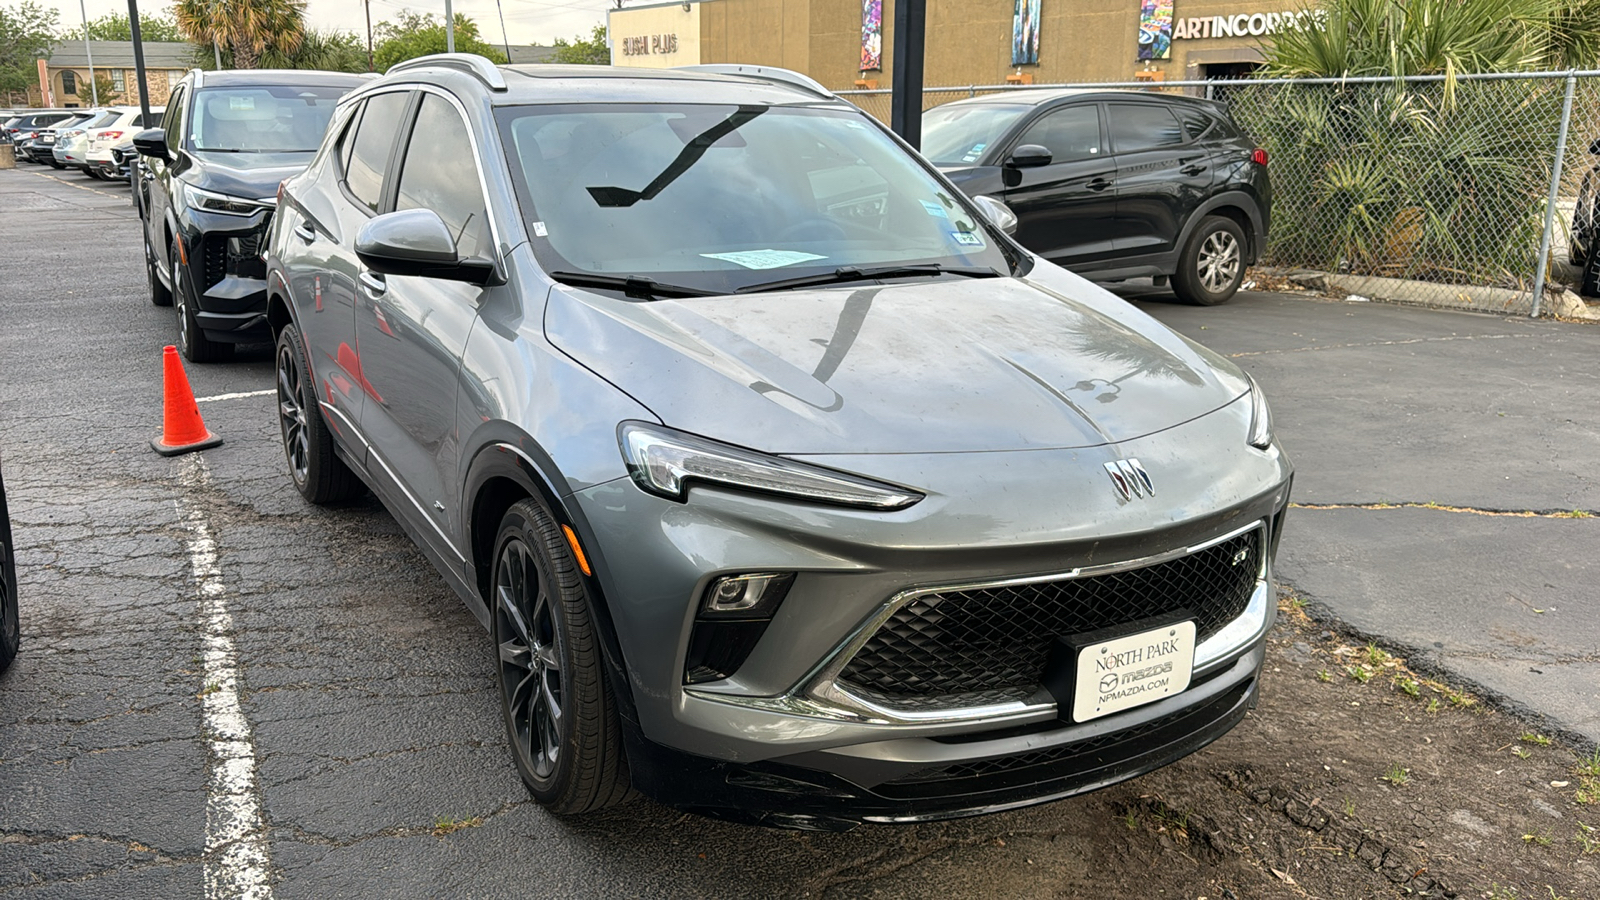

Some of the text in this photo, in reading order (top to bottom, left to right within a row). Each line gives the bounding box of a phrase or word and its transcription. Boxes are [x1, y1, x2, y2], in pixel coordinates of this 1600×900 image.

[622, 33, 678, 56] SUSHI PLUS
[1095, 637, 1179, 673] NORTH PARK
[1121, 661, 1173, 685] mazda
[1098, 677, 1169, 704] NPMAZDA.COM
